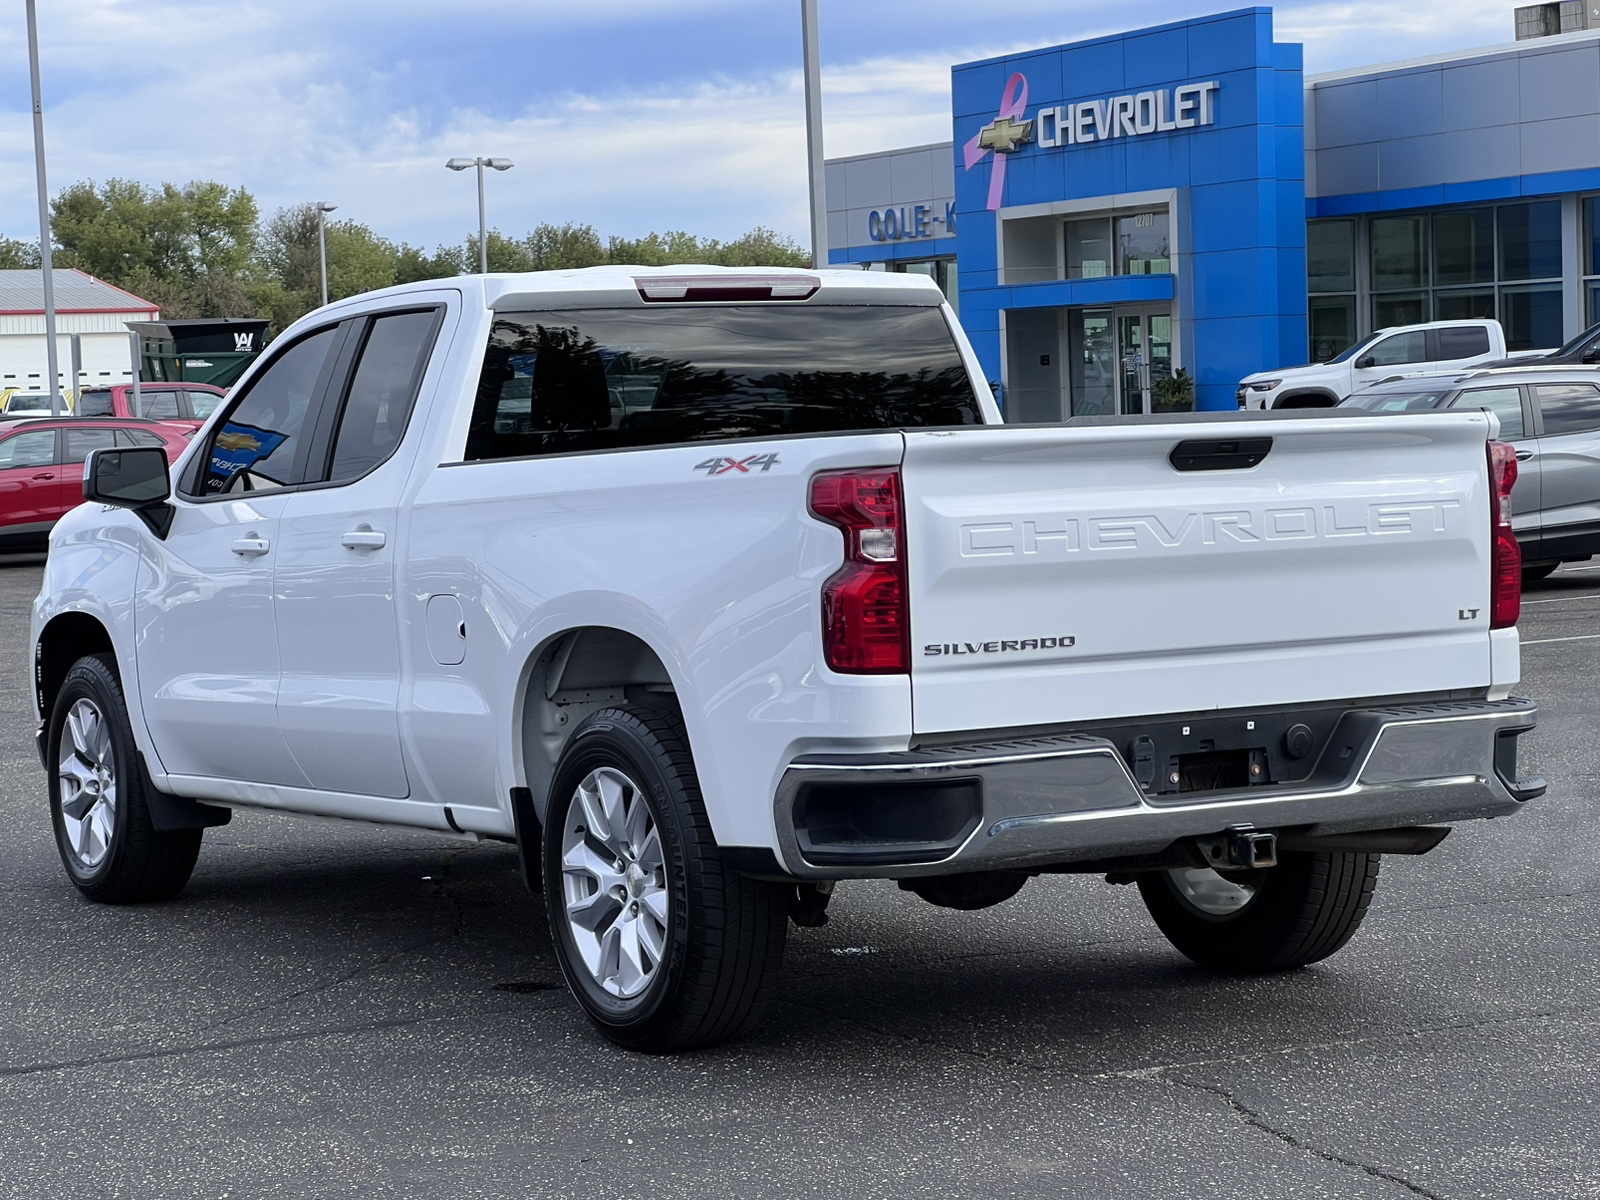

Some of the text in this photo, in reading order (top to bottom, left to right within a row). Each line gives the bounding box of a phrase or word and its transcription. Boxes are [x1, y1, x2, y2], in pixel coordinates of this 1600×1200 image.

[1037, 81, 1220, 149] CHEVROLET
[1134, 213, 1154, 227] 12707
[959, 499, 1460, 559] CHEVROLET
[1458, 608, 1481, 620] LT
[924, 635, 1076, 656] SILVERADO
[651, 782, 686, 931] ENCOUNTER
